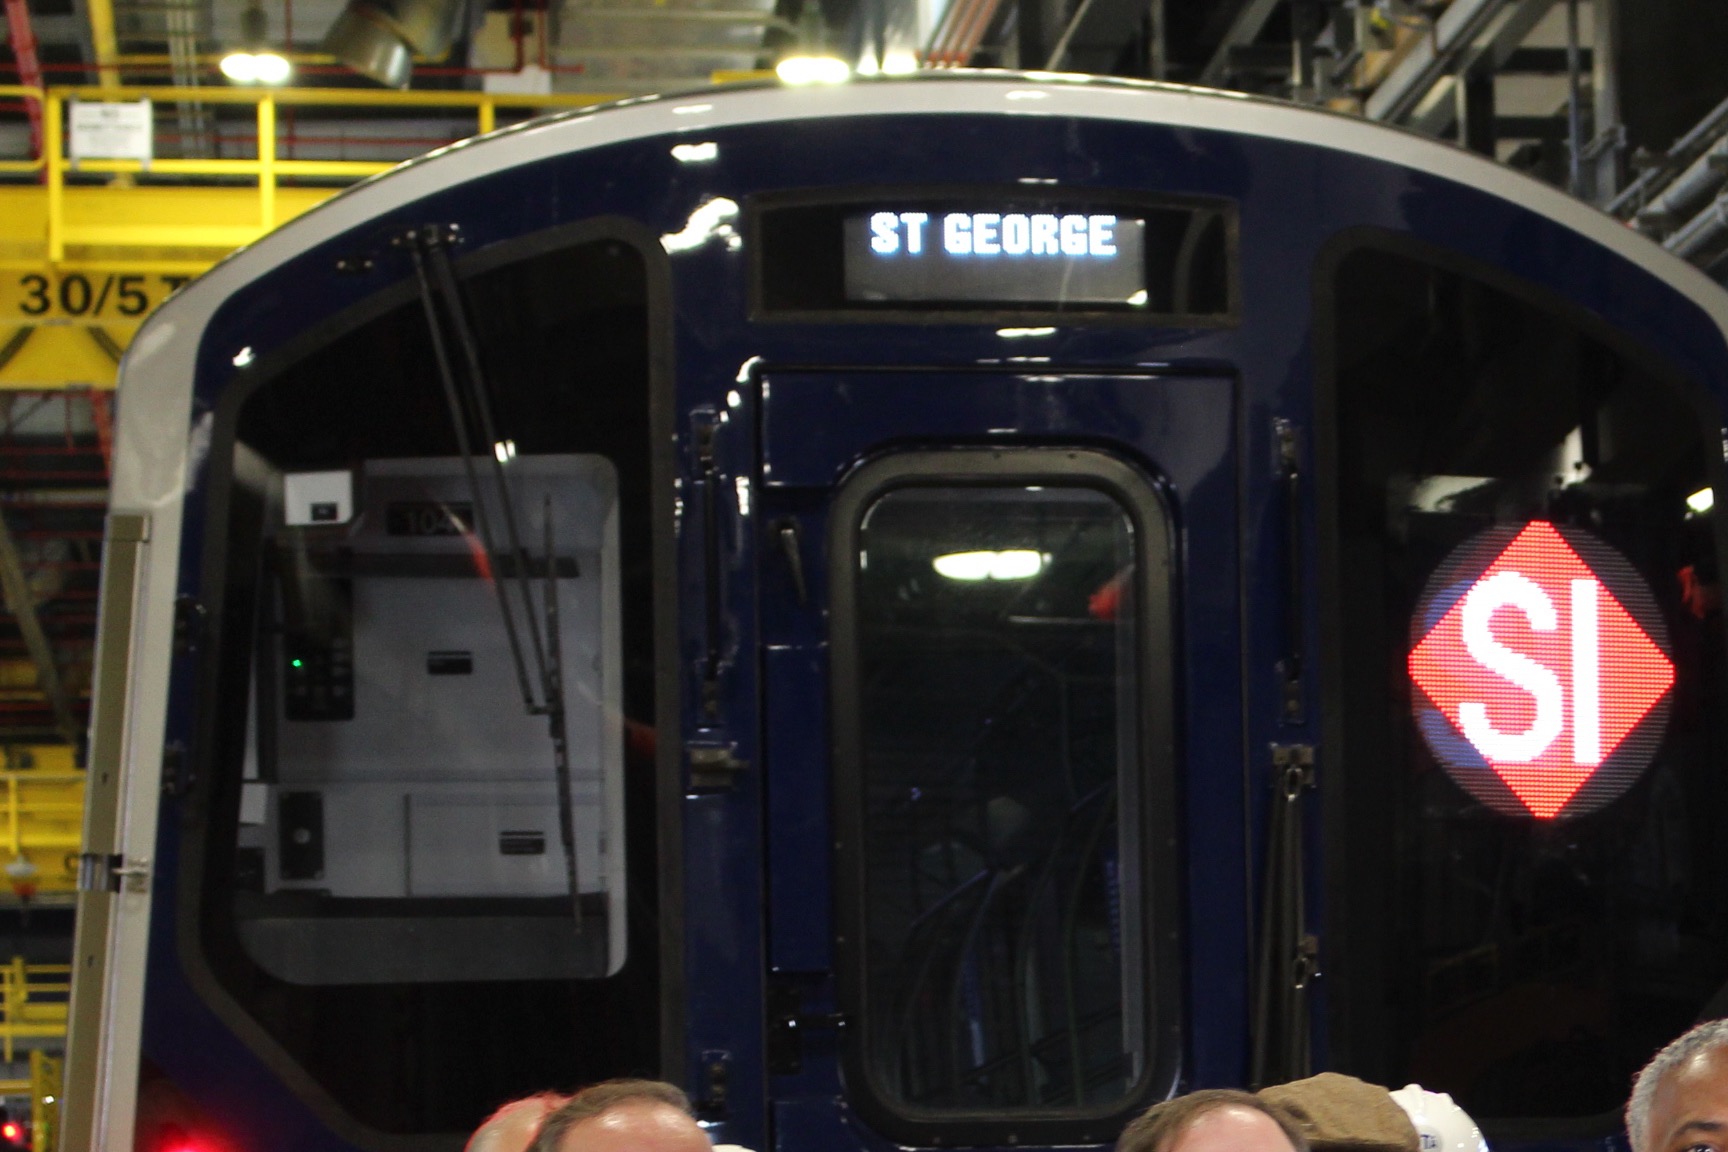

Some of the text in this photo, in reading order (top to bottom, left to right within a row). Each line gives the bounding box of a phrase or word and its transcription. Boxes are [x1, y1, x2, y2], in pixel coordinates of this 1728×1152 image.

[870, 211, 1118, 256] ST GEORGE
[20, 273, 149, 316] 30/5
[1459, 571, 1600, 764] SI
